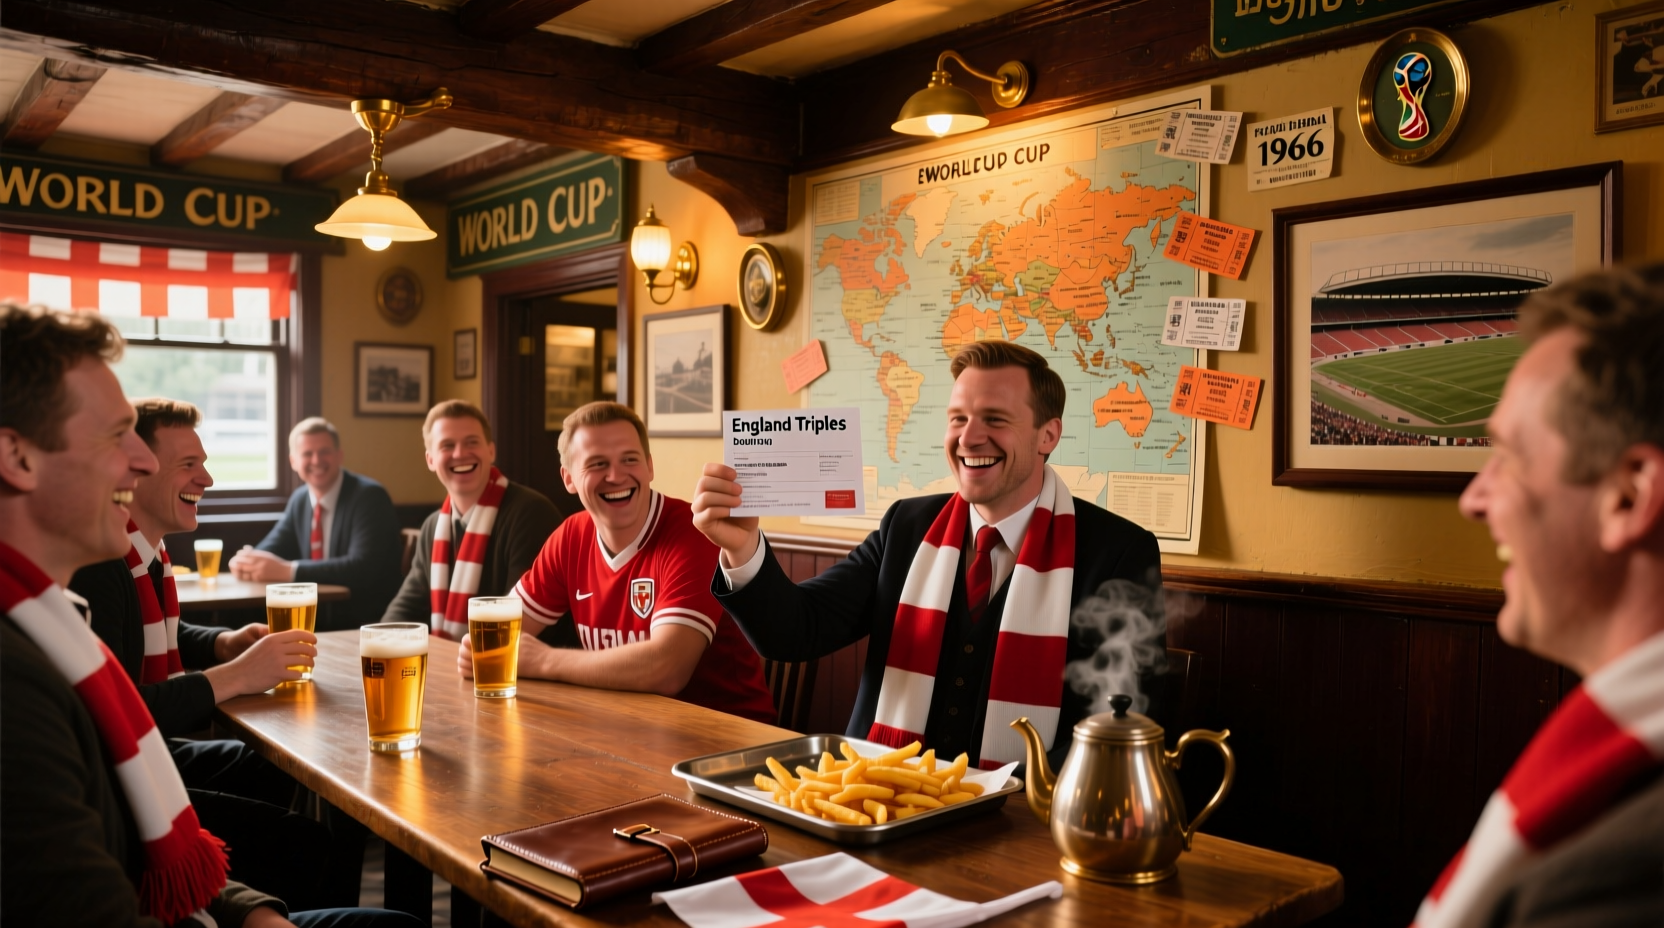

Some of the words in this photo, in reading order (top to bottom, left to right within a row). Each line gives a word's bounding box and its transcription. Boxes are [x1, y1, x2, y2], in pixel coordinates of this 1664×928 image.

[1014, 143, 1051, 165] CUP
[1257, 128, 1325, 167] 1966
[0, 166, 164, 219] WORLD
[184, 187, 271, 230] CUP
[458, 198, 539, 257] WORLD
[547, 177, 606, 234] CUP
[732, 416, 792, 436] England
[795, 415, 847, 435] Triples
